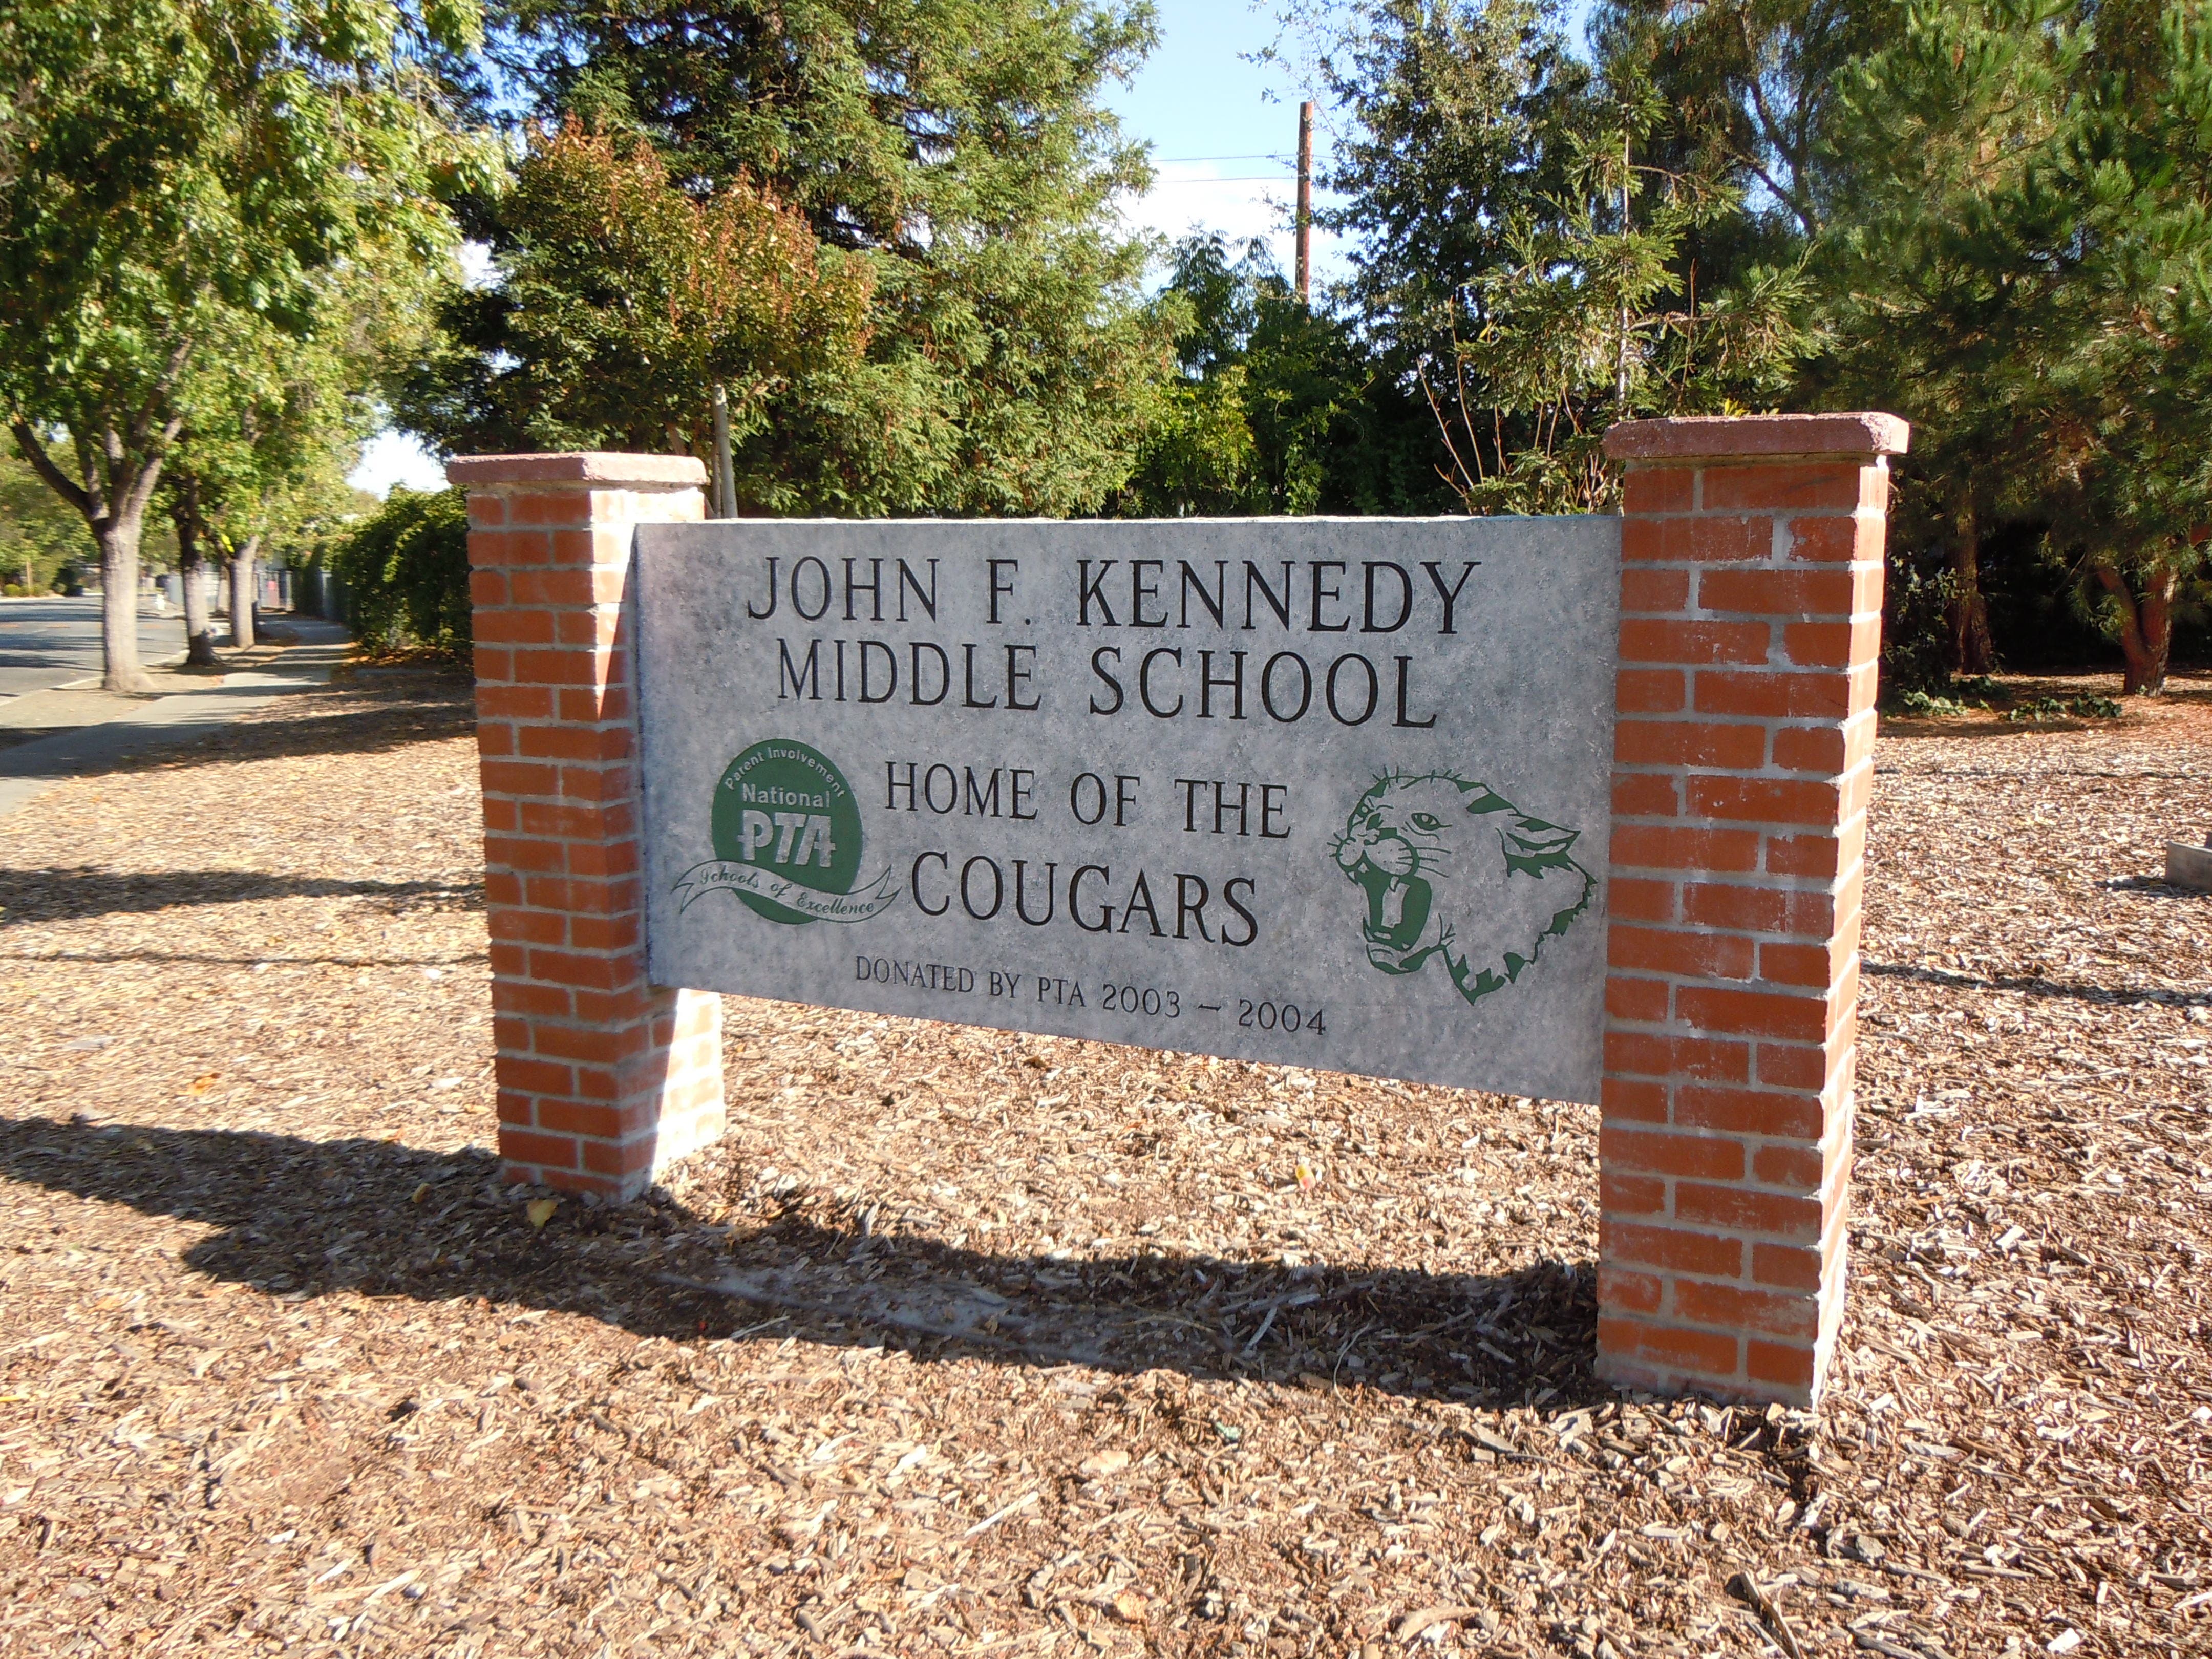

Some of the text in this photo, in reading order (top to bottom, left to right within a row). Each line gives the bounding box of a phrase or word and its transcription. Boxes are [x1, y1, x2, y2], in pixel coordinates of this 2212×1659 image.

[745, 556, 1482, 634] JOHN F. KENNEDY
[776, 638, 1438, 729] MIDDLE SCHOOL
[725, 747, 845, 797] Parent Involvement
[742, 782, 830, 807] National
[884, 761, 1291, 839] HOME OF THE
[738, 809, 836, 867] PTA
[700, 865, 875, 914] Schools of Excellence
[911, 851, 1258, 947] COUGARS
[856, 955, 974, 993] DONATED
[989, 971, 1022, 998] BY
[1037, 976, 1087, 1007] PTA
[1102, 983, 1181, 1018] 2003
[1238, 998, 1326, 1036] 2004
